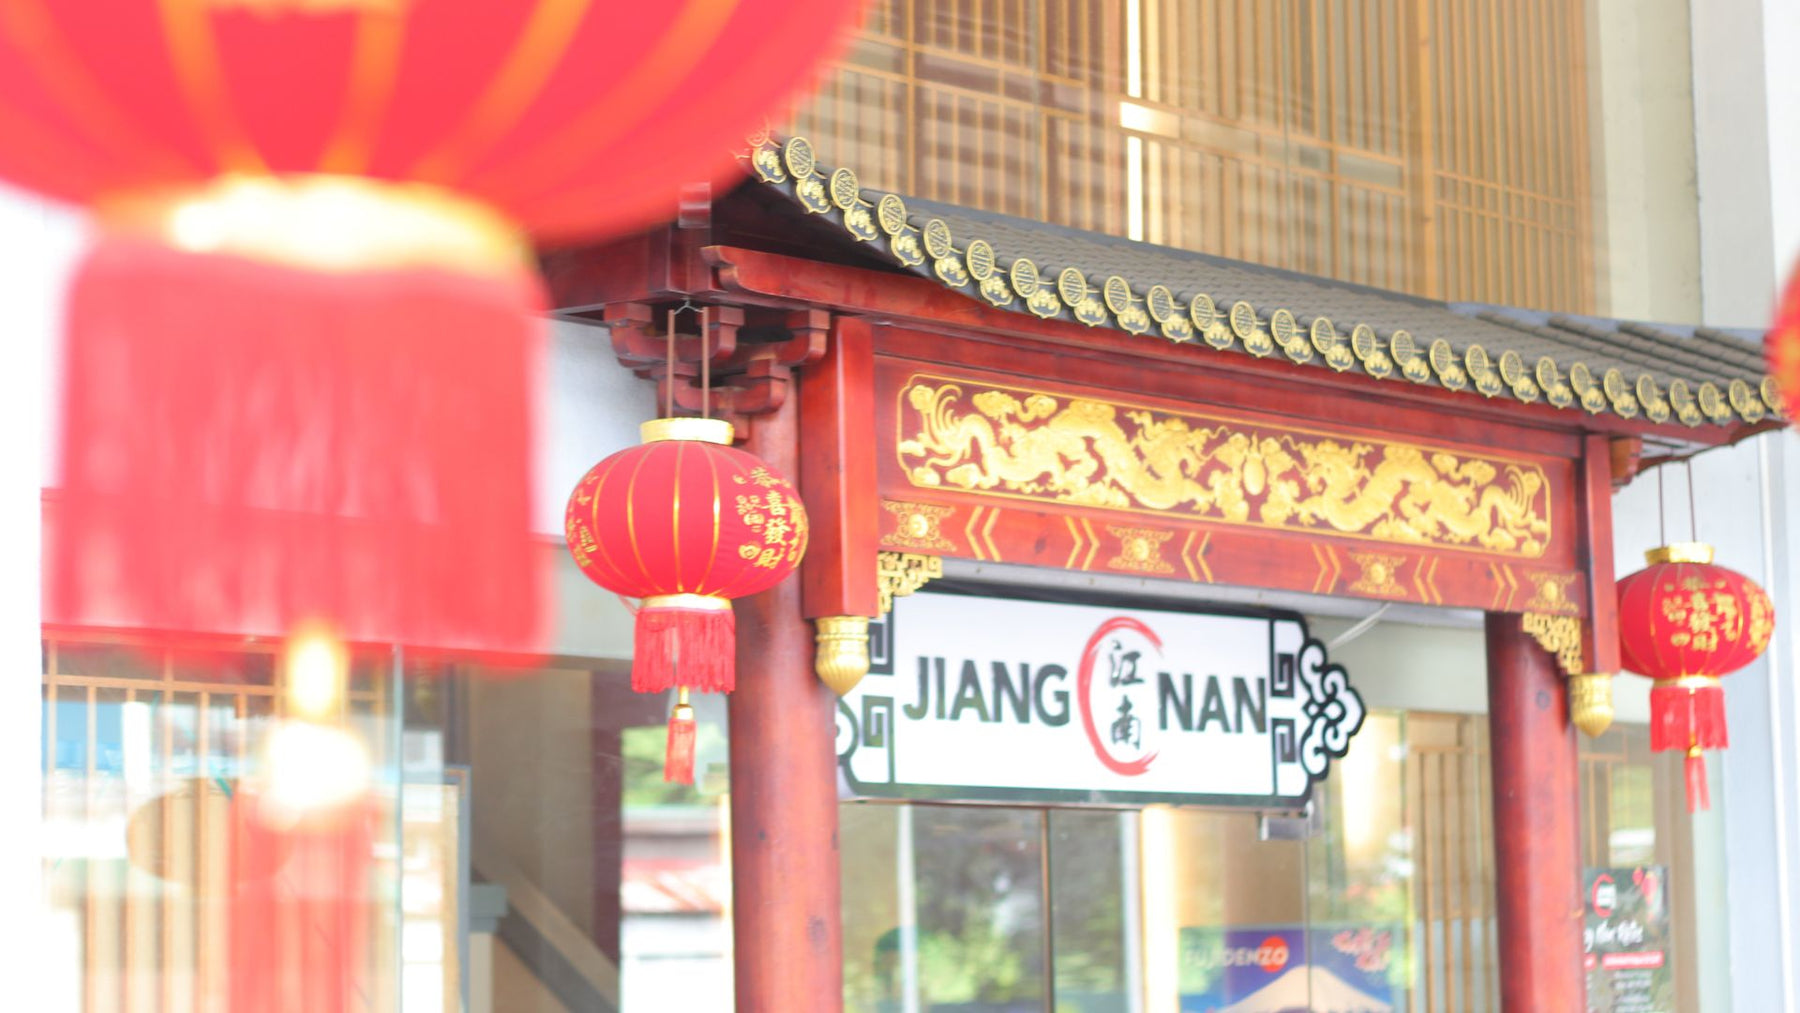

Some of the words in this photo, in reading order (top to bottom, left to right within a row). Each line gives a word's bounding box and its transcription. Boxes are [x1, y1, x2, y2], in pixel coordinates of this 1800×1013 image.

[903, 655, 1071, 727] JIANG
[1156, 671, 1268, 734] NAN
[1108, 639, 1145, 750] 江南
